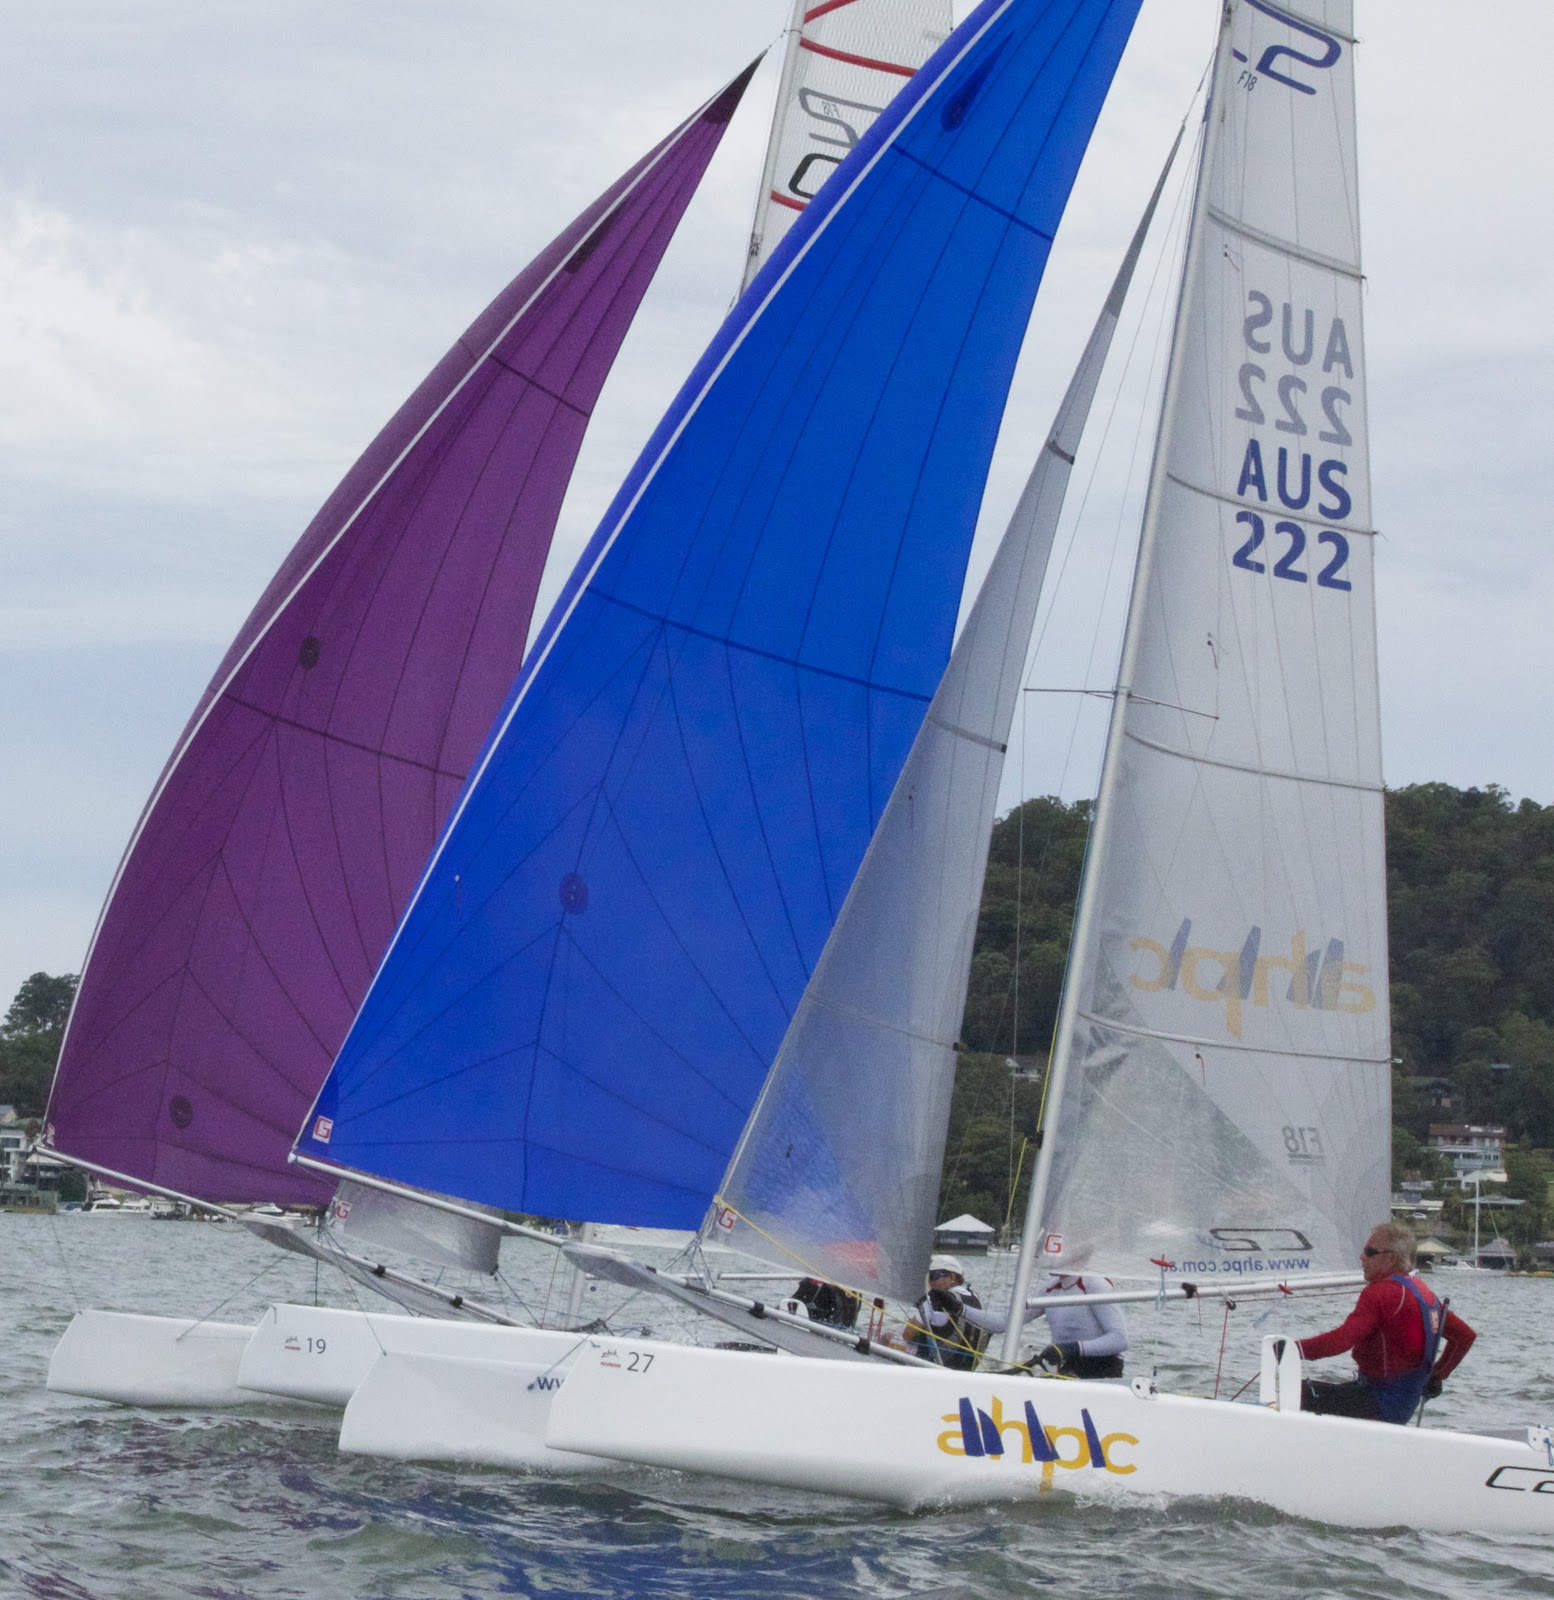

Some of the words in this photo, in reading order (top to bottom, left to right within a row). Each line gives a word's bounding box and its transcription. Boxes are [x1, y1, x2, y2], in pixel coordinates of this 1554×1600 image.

[1237, 70, 1258, 92] F18
[1236, 438, 1352, 521] AUS
[1232, 510, 1352, 592] 222
[1044, 1233, 1063, 1254] G
[307, 1337, 327, 1355] 19
[627, 1351, 655, 1373] 27
